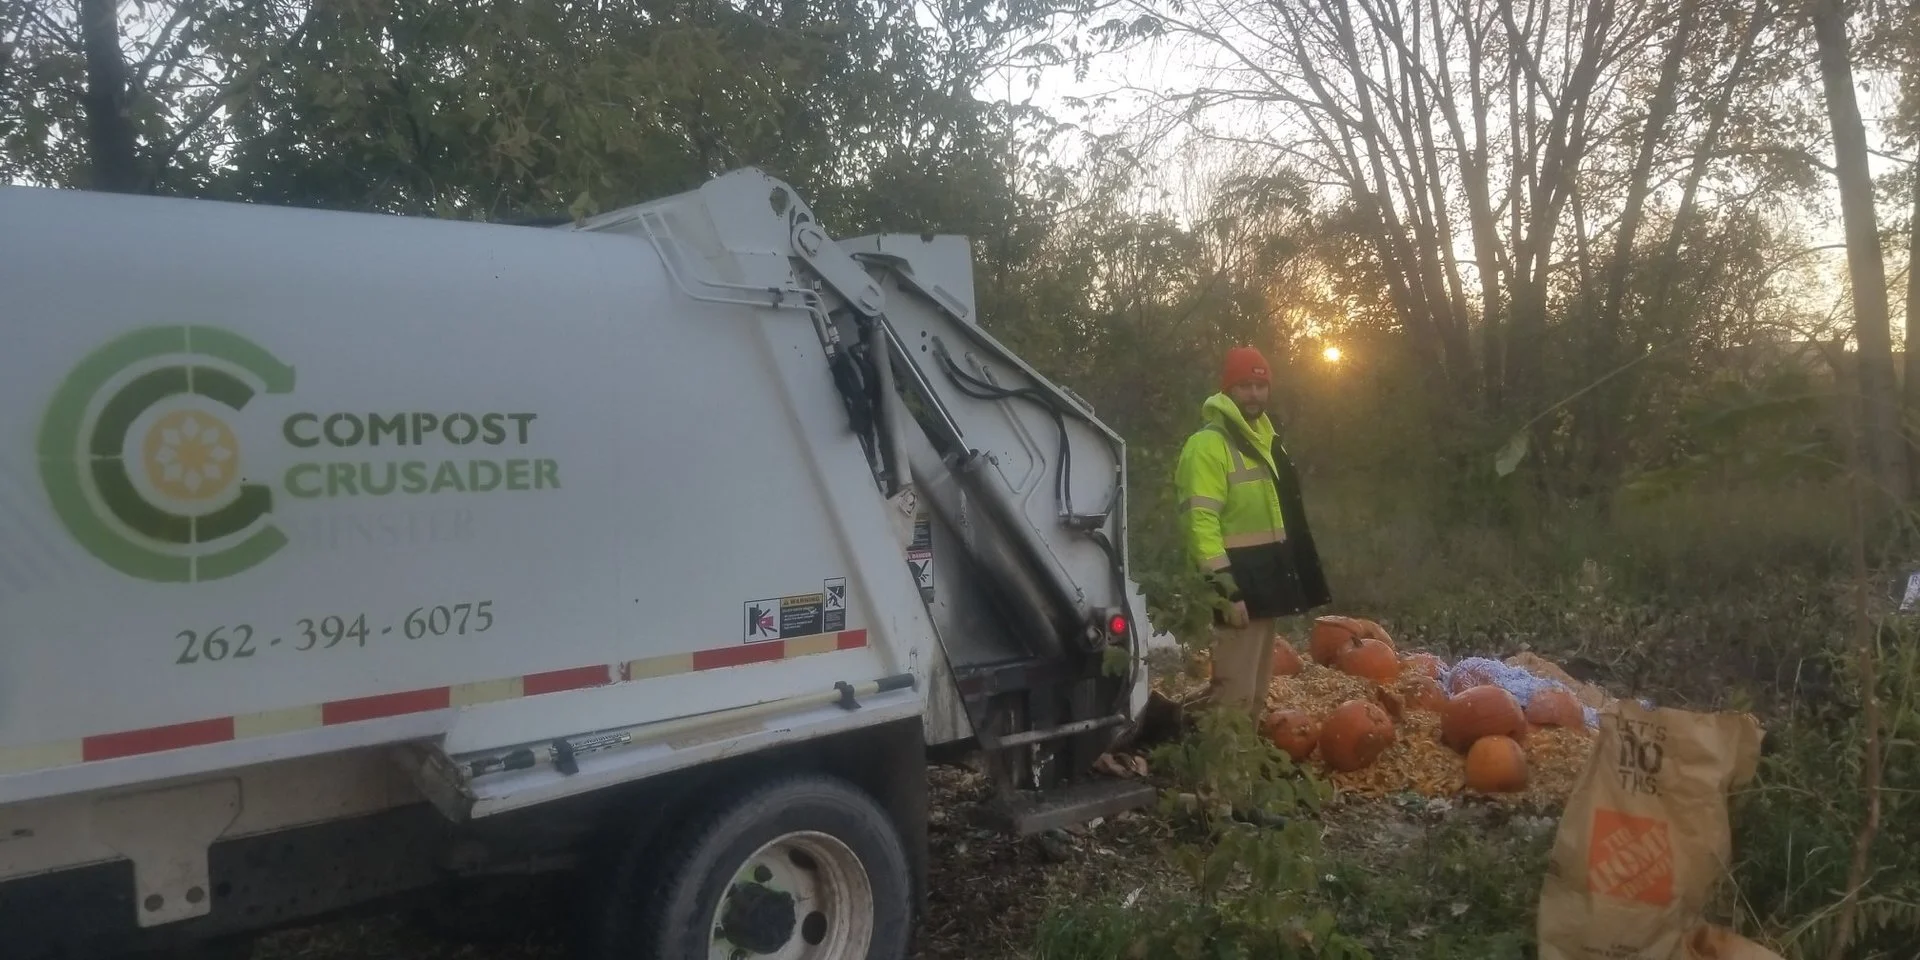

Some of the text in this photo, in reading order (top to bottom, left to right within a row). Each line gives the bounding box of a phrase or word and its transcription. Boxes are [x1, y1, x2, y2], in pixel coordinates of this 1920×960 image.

[282, 412, 538, 448] COMPOST
[284, 458, 562, 498] CRUSADER
[1619, 733, 1664, 774] DO
